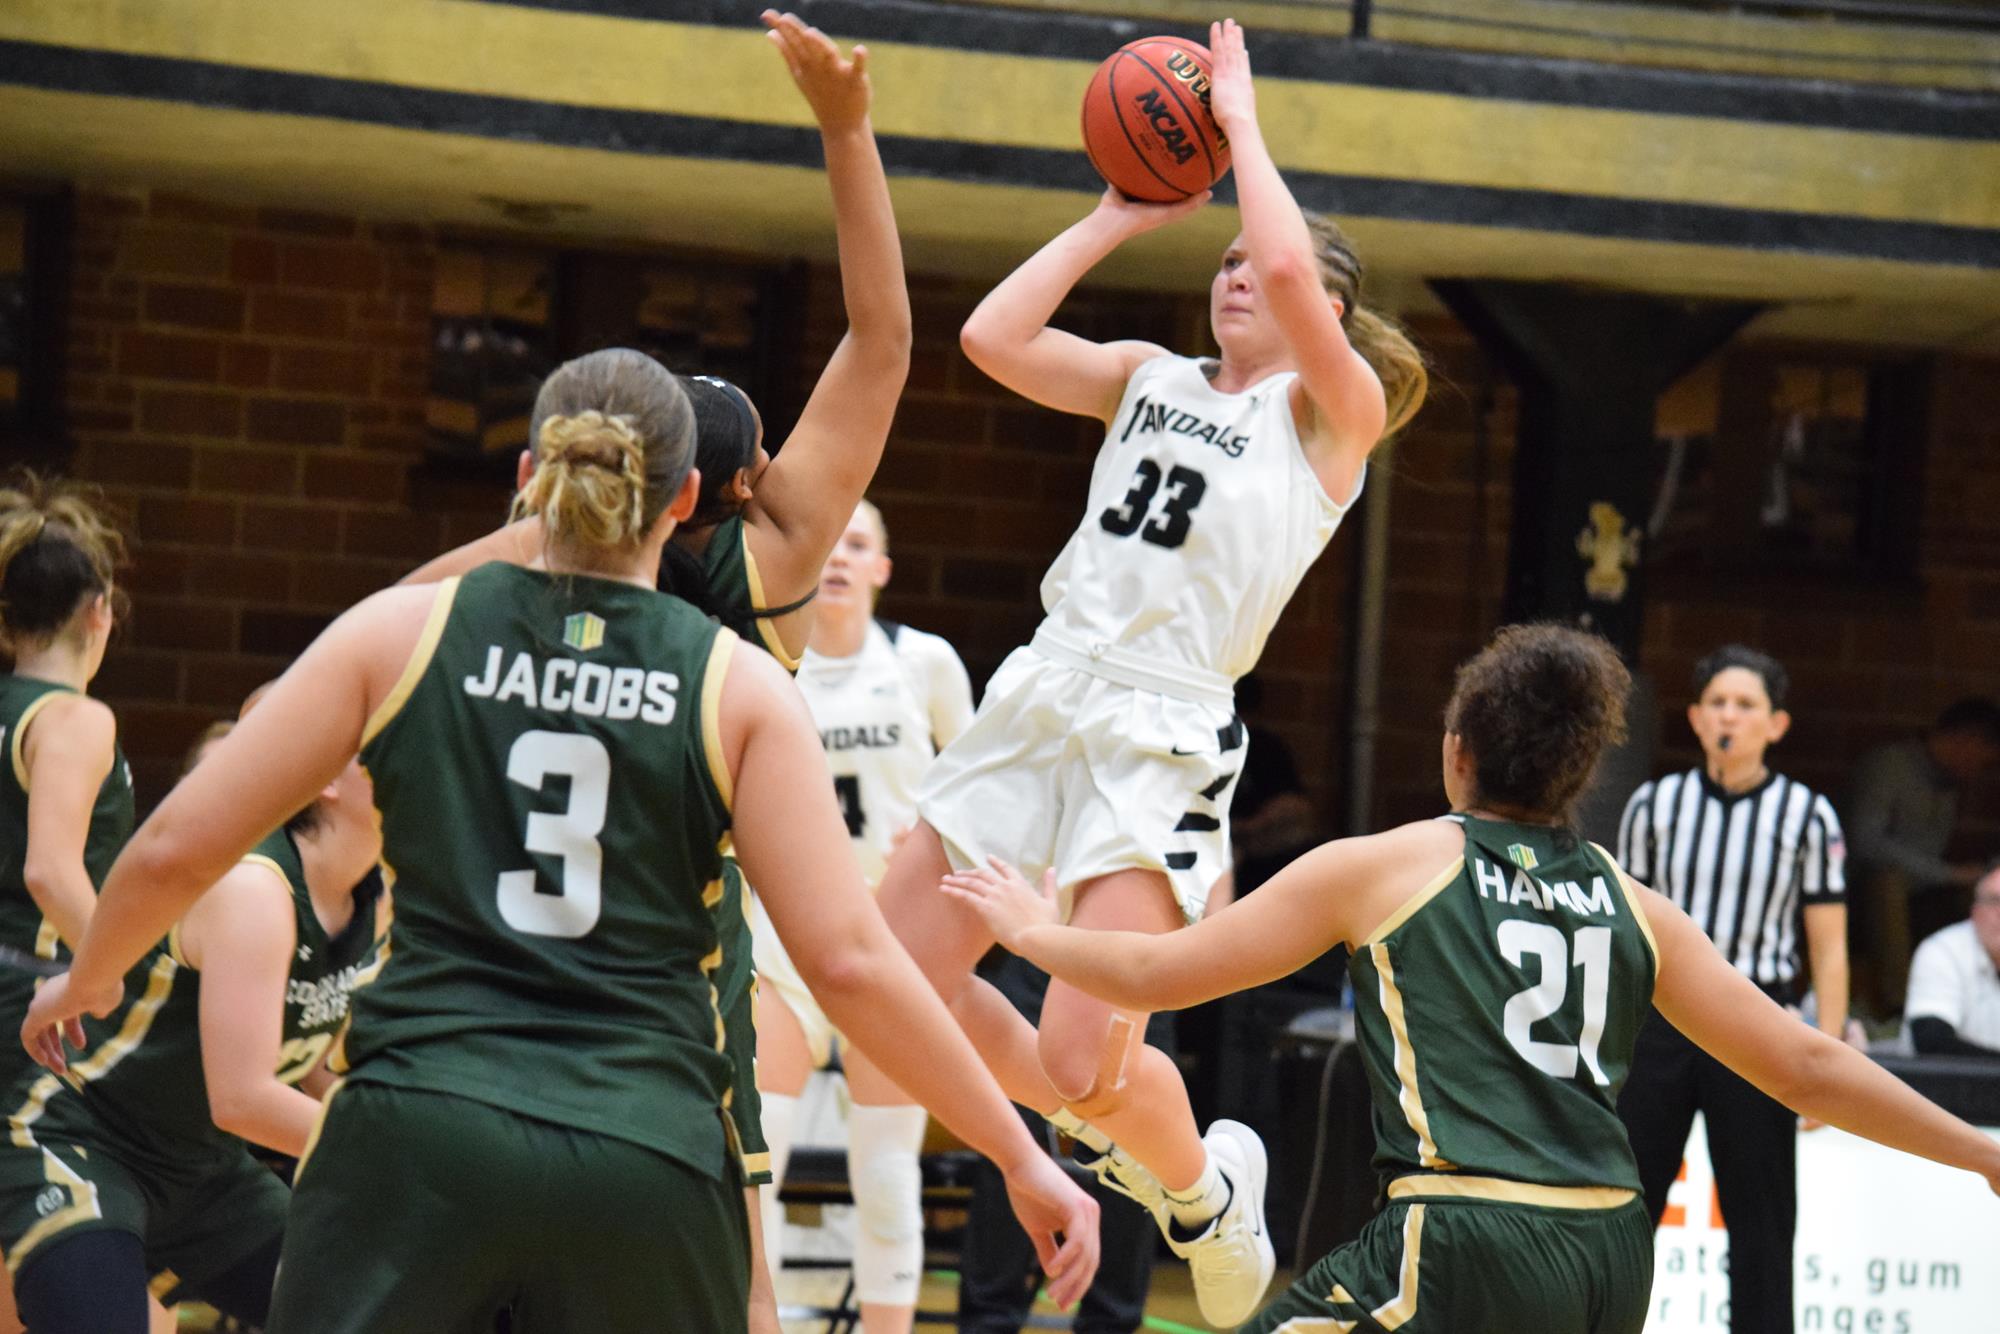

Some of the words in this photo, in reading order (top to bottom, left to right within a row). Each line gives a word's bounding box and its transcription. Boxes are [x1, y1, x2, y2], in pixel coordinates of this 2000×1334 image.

[1135, 88, 1198, 165] NCAA
[1099, 458, 1207, 548] 33
[463, 644, 680, 726] JACOBS
[496, 728, 612, 939] 3
[1474, 857, 1617, 917] HAMM
[1496, 918, 1612, 1086] 21
[1867, 1257, 1962, 1295] gum
